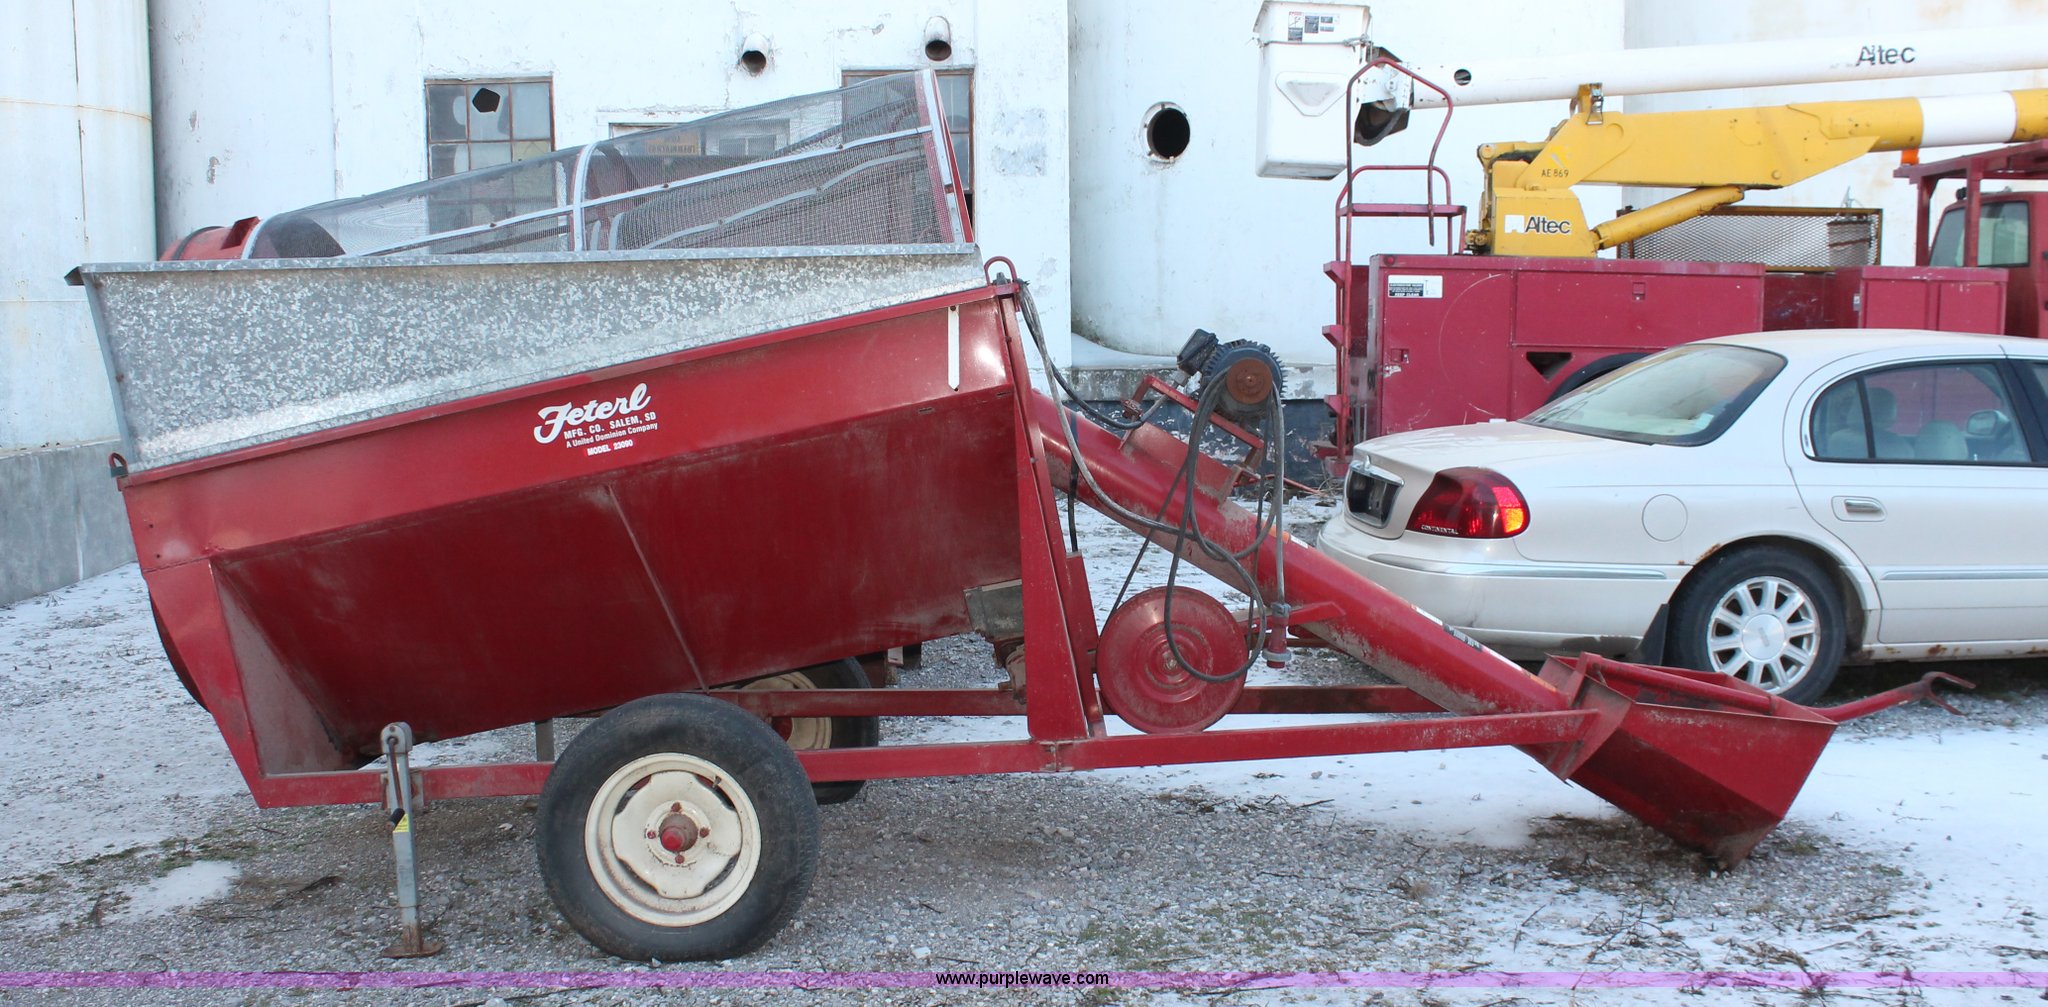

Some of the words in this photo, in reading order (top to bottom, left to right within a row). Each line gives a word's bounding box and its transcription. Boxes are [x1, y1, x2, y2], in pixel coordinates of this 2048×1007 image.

[1856, 45, 1915, 66] Altec
[1541, 169, 1552, 178] AE
[1553, 169, 1569, 178] 869
[1525, 216, 1571, 234] Altec
[534, 383, 652, 444] Feterl
[563, 428, 587, 439] MFG.
[588, 424, 605, 434] CO.
[609, 415, 643, 429] SALEM,
[644, 411, 657, 421] SD
[566, 440, 572, 448] A
[572, 435, 594, 447] United
[595, 430, 626, 442] Dominion
[627, 423, 658, 434] Company
[587, 444, 611, 456] MODEL
